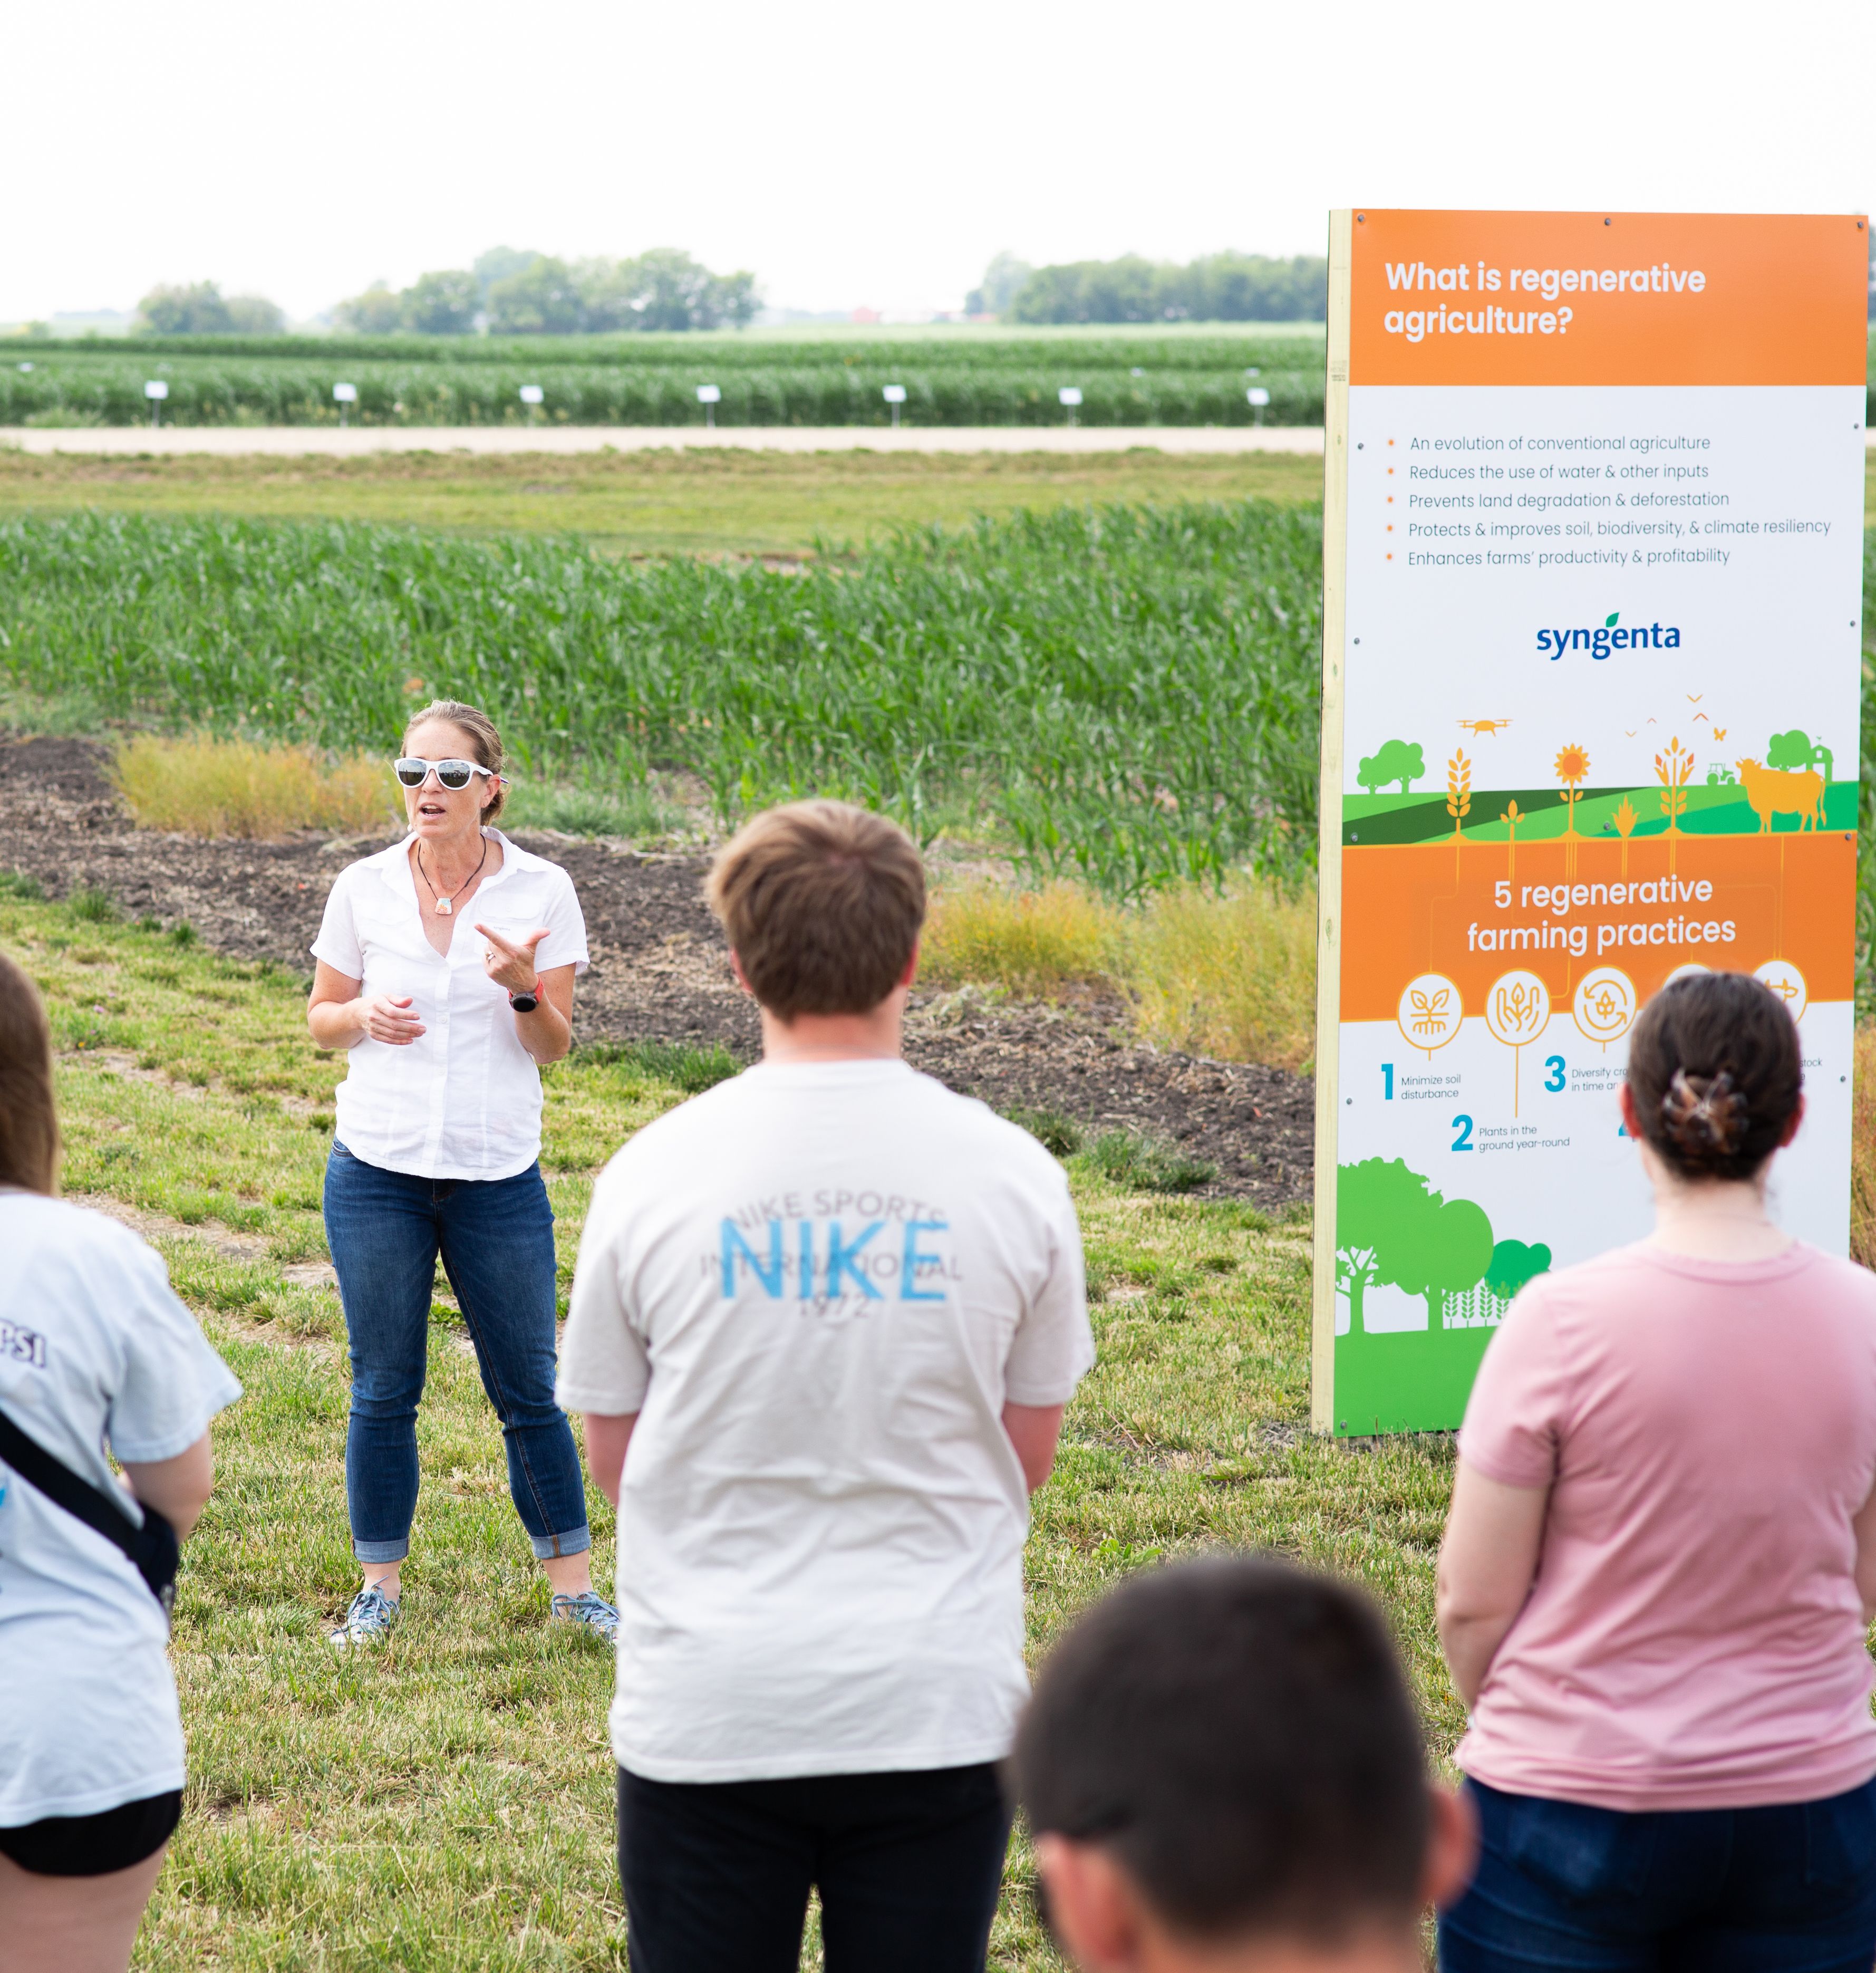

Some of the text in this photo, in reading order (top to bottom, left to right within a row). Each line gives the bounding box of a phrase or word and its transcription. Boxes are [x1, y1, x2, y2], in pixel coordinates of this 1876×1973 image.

[1385, 261, 1706, 301] What is regenerative
[1384, 304, 1573, 342] agriculture?
[1410, 436, 1710, 454] An evolution of conventional agriculture
[1410, 464, 1709, 482] Reduces the use of water & other inputs
[1409, 492, 1729, 512] Prevents land degradation & deforestation
[1409, 519, 1831, 540] Protects & improves soil, biodiversity, & climate resiliency
[1409, 551, 1482, 565] Enhances
[1539, 549, 1628, 568] productivity
[1632, 550, 1642, 563] &
[1647, 548, 1730, 567] profitability
[1536, 621, 1680, 660] syngenta
[1494, 874, 1713, 916] 5 regenerative
[1467, 915, 1736, 957] farming practices
[1799, 1057, 1822, 1068] stock
[1381, 1063, 1394, 1100] 1
[1401, 1074, 1461, 1086] Minimize soil
[1544, 1055, 1566, 1093] 3
[1572, 1067, 1611, 1079] Diversify
[1401, 1089, 1459, 1100] disturbance
[1571, 1083, 1580, 1092] in
[1582, 1082, 1604, 1091] time
[1451, 1114, 1474, 1152] 2
[1479, 1128, 1508, 1137] Plants
[1521, 1125, 1537, 1135] the
[1478, 1137, 1570, 1153] ground year-round
[720, 1219, 949, 1301] NIKE
